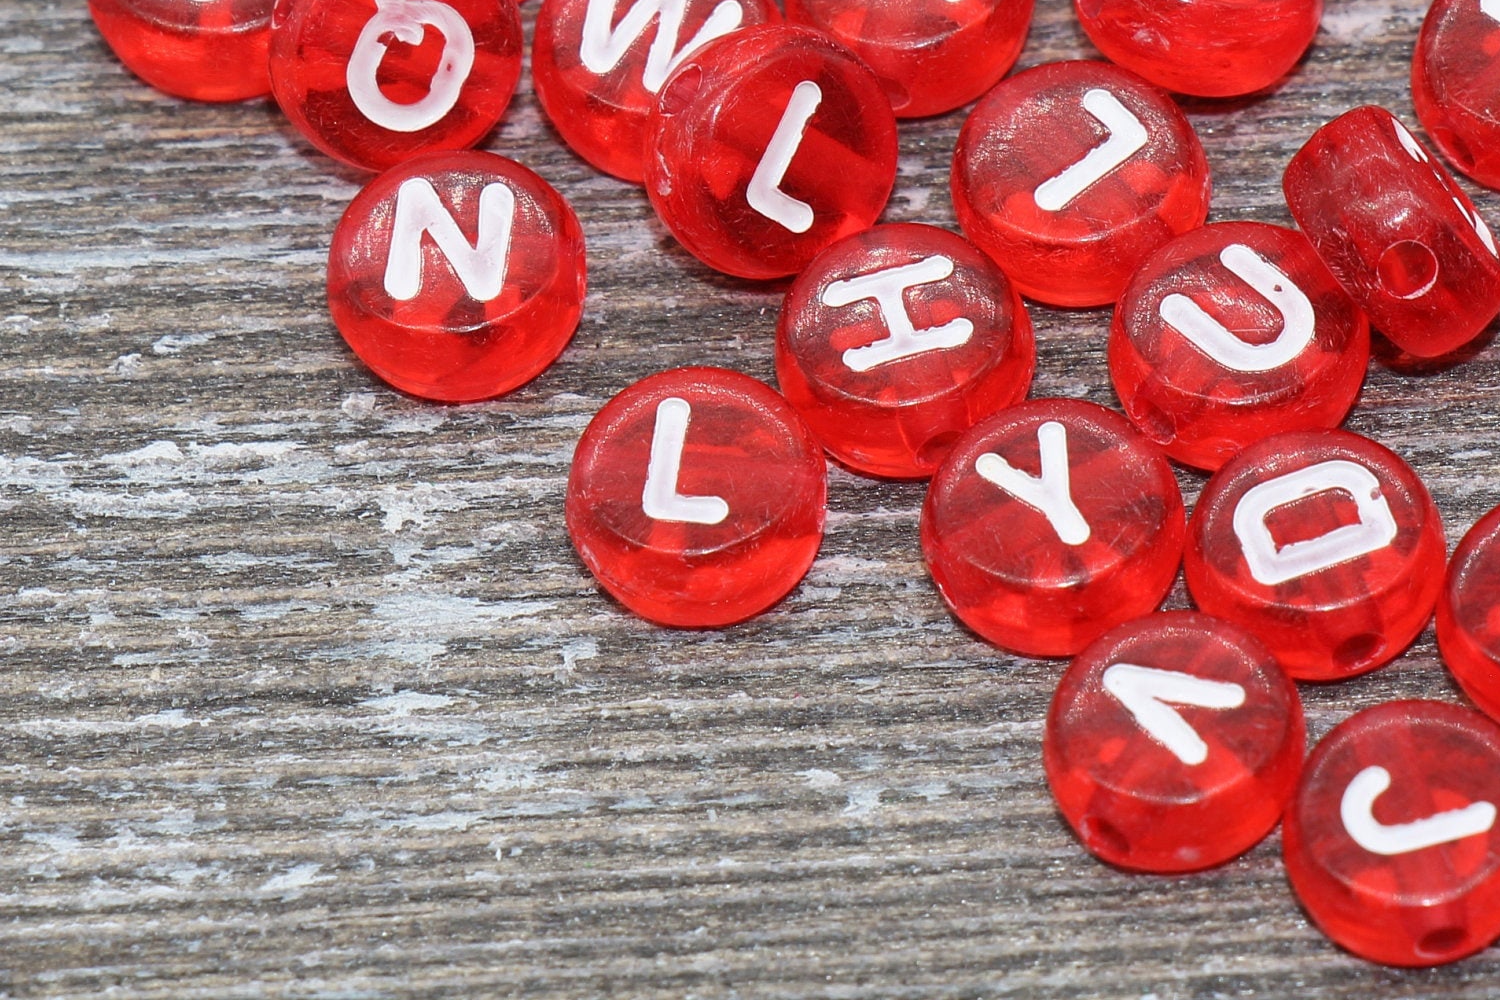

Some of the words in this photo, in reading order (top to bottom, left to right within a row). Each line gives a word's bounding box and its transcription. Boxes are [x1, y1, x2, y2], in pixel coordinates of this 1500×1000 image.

[746, 80, 822, 234] L
[1033, 87, 1149, 212] L
[383, 176, 516, 303] N
[821, 254, 974, 373] H
[1159, 243, 1316, 372] U
[642, 396, 729, 525] L
[975, 420, 1091, 546] Y
[1232, 459, 1398, 586] D
[1102, 663, 1246, 766] V
[1340, 765, 1497, 855] J
